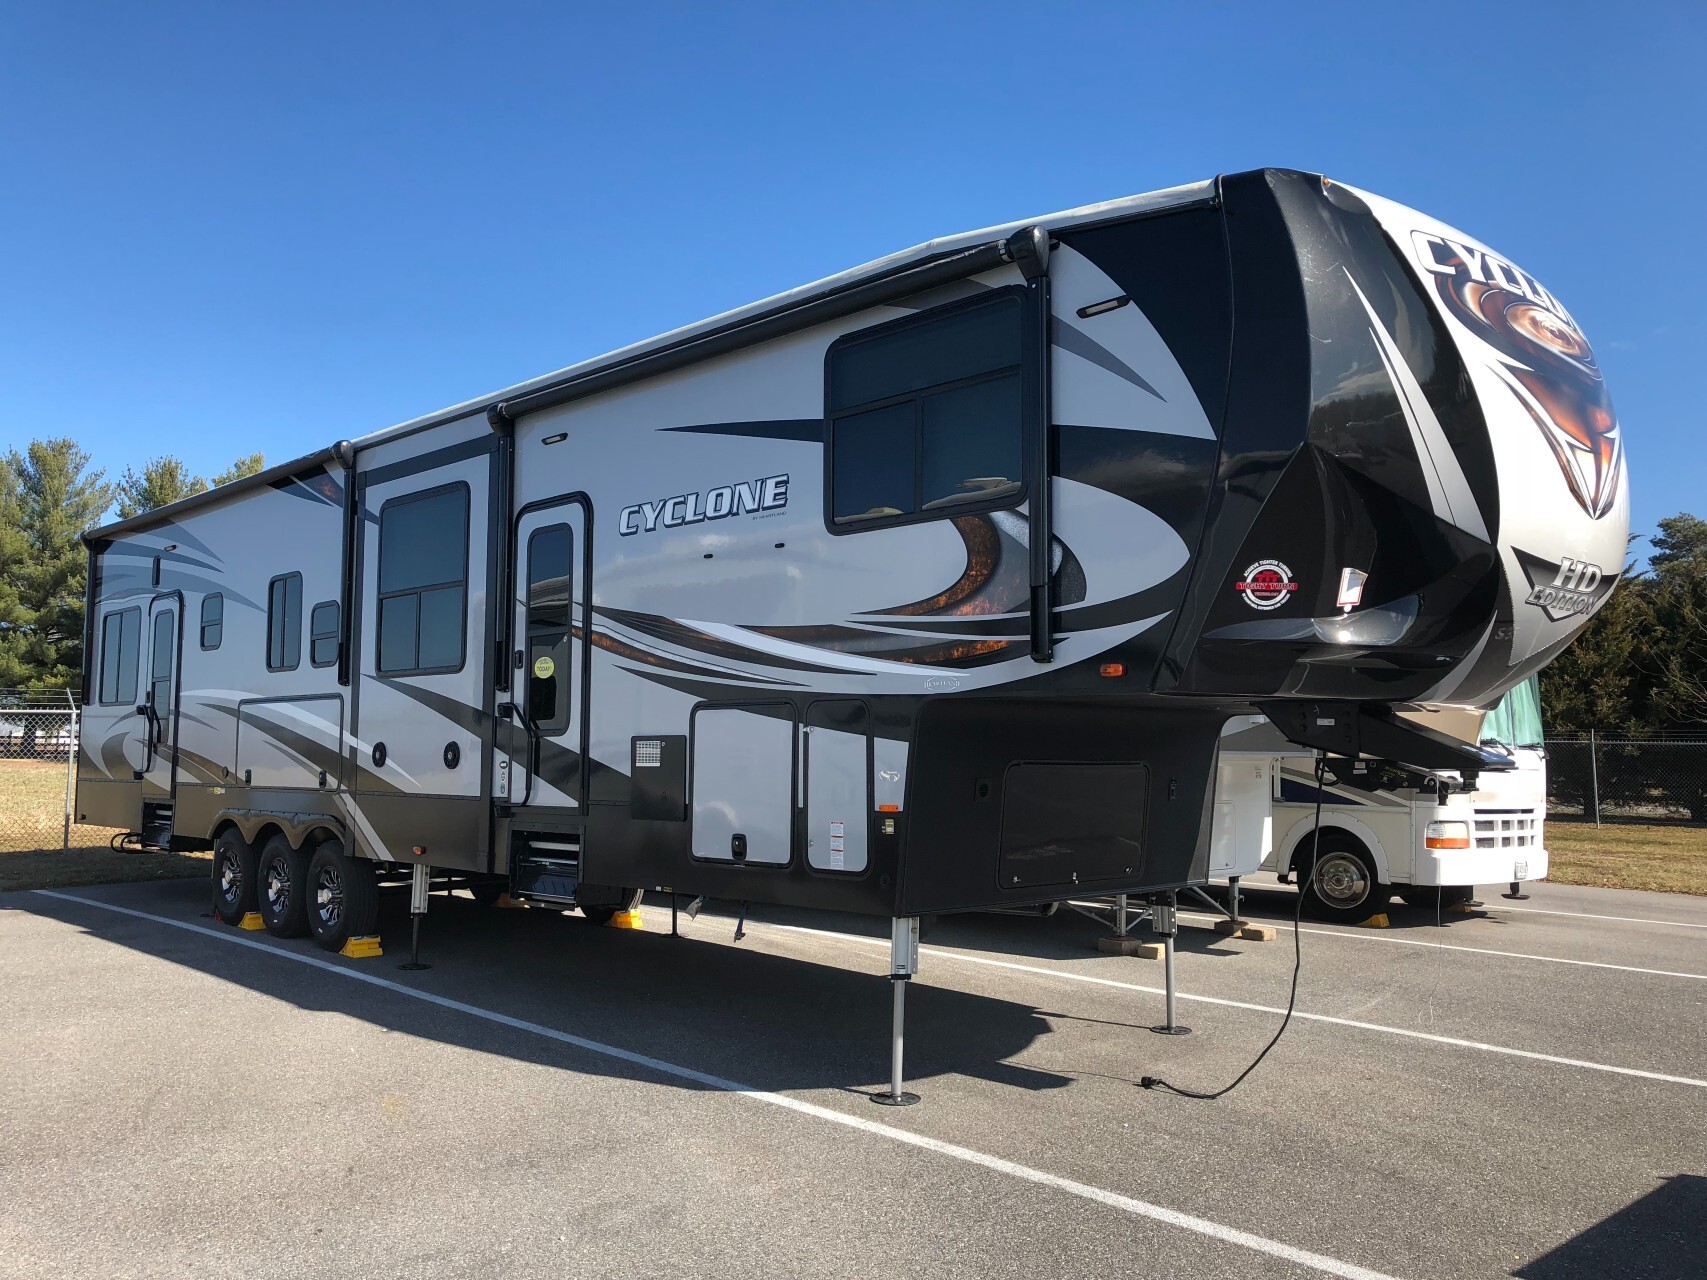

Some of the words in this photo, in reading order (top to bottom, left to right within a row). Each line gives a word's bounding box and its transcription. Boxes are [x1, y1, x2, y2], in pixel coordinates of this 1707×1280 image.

[1410, 229, 1574, 328] CYCLO
[619, 473, 789, 537] CYCLONE
[1240, 582, 1267, 590] TIGHT
[1269, 582, 1295, 590] TURN
[1551, 556, 1602, 594] HD
[1525, 584, 1598, 615] EDITION
